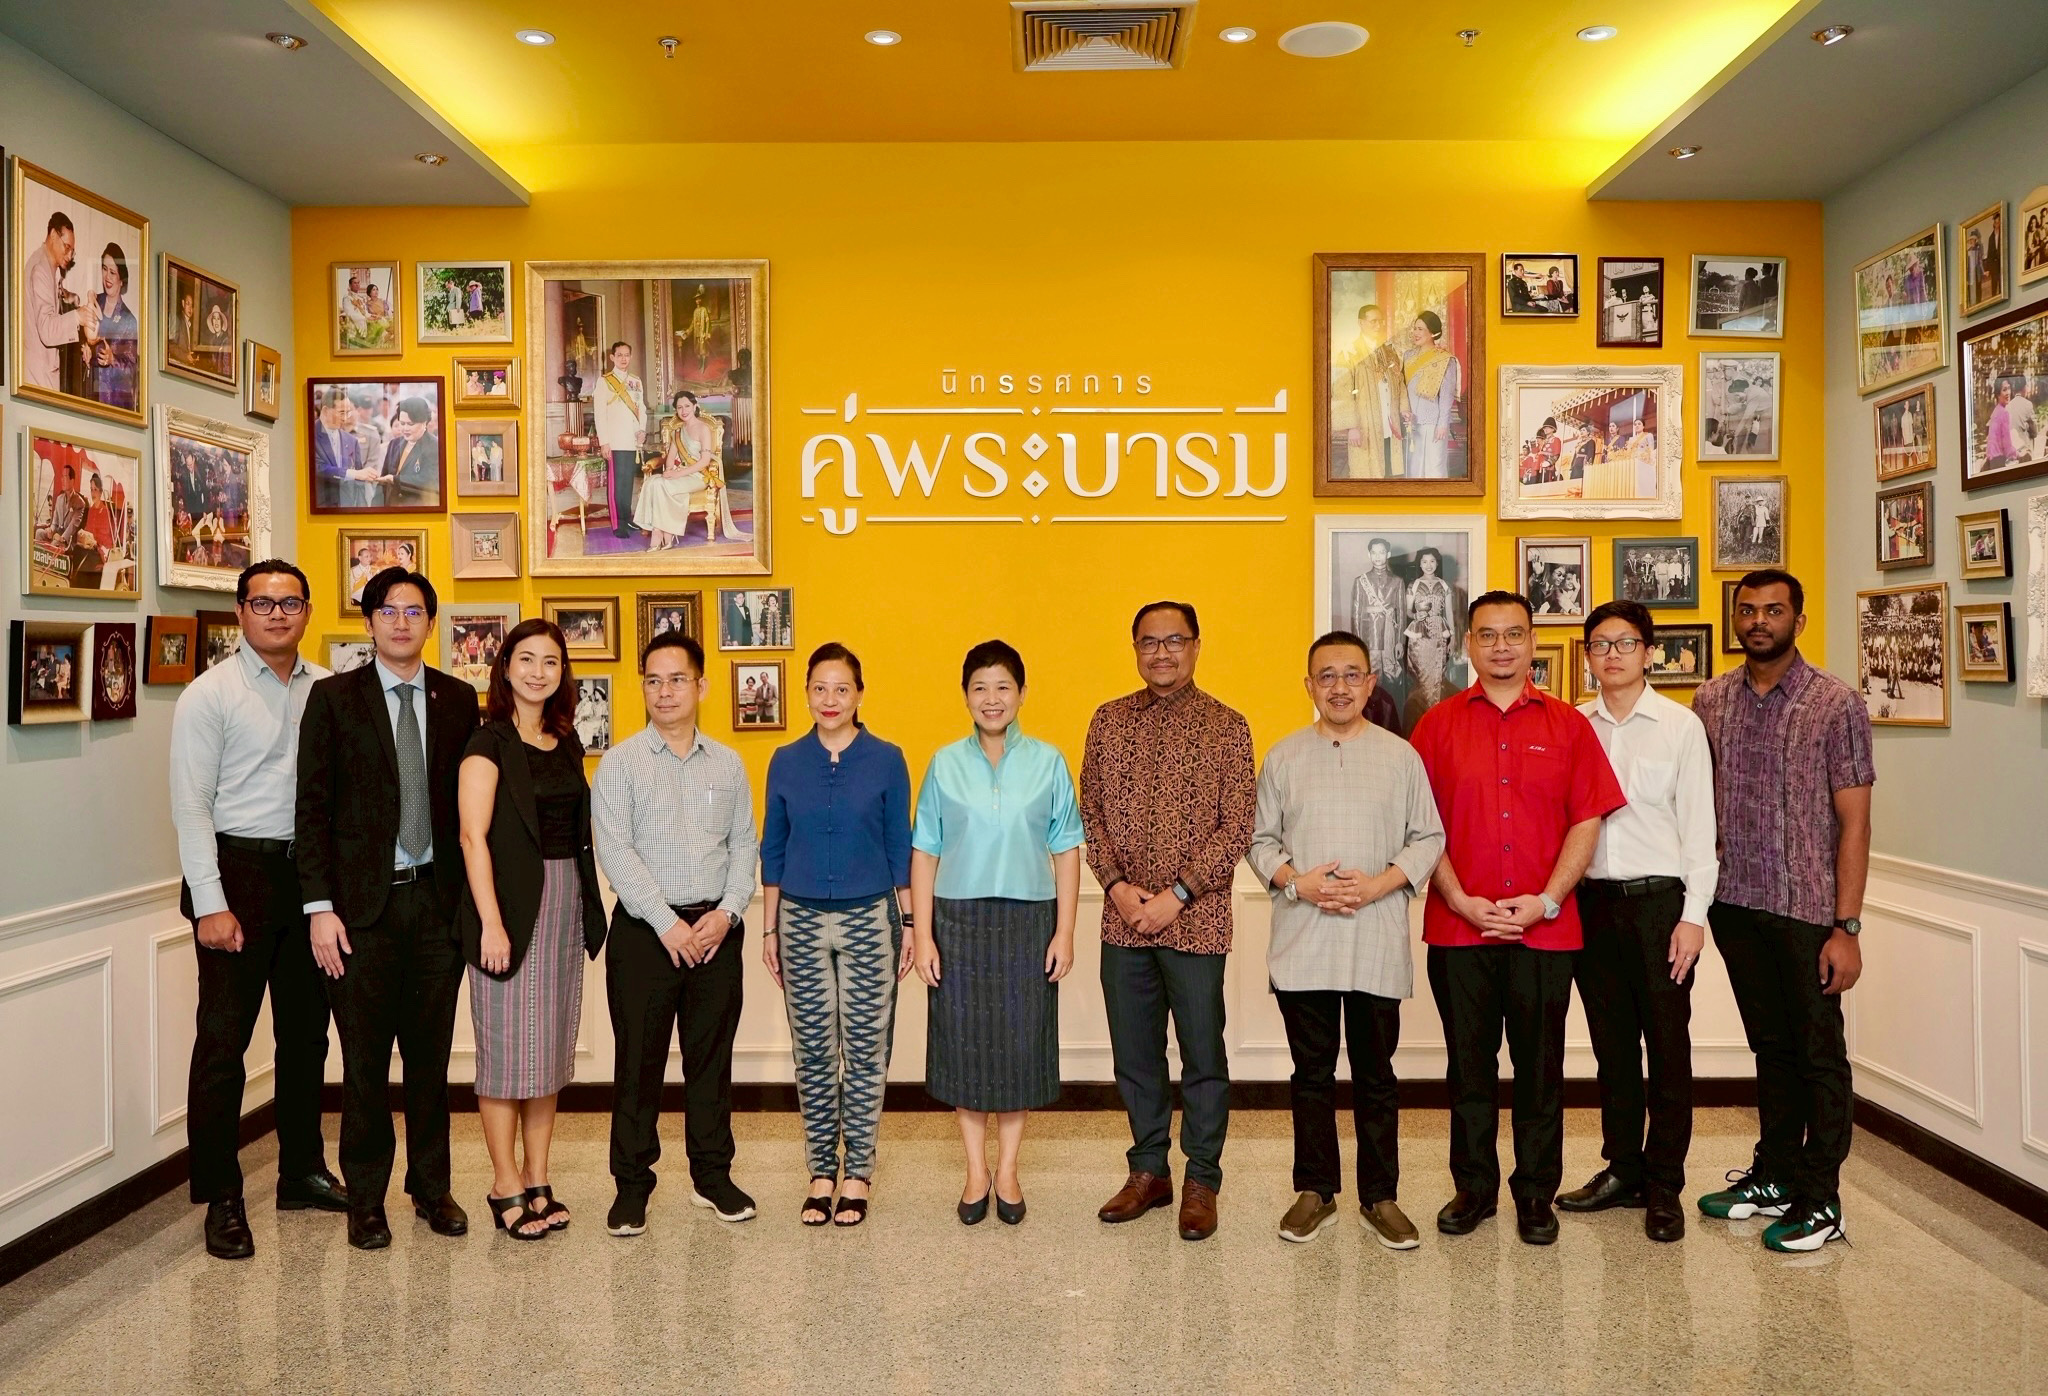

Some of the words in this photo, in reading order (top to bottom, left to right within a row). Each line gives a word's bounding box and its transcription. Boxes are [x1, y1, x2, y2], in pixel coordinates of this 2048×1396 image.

[942, 368, 1152, 394] นิทรรศการ
[801, 389, 1289, 535] คู่พระบารมี
